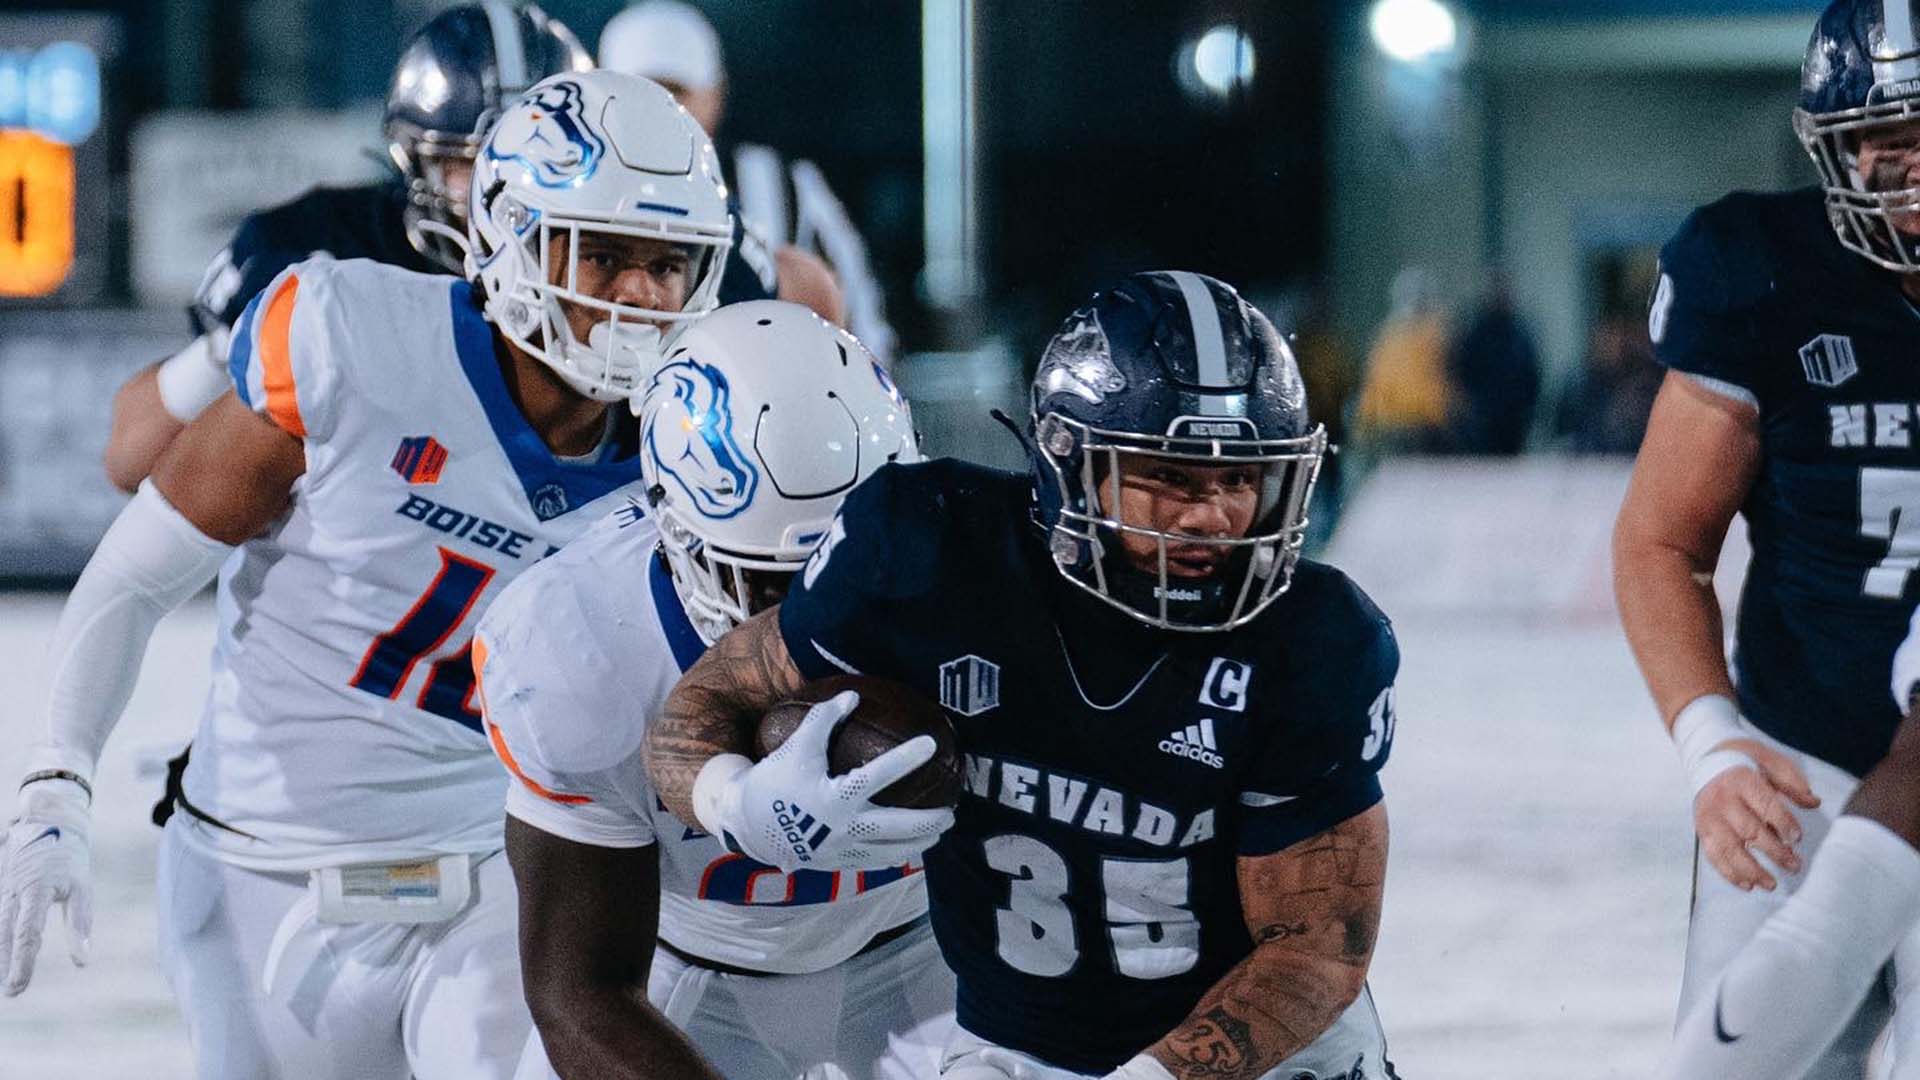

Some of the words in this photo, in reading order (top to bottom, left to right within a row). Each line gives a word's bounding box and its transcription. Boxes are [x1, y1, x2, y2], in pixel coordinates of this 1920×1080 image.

[1830, 404, 1920, 447] NE
[396, 493, 534, 559] BOISE
[1209, 659, 1244, 708] C
[1158, 740, 1224, 769] adidas
[772, 799, 812, 863] adidas
[962, 752, 1216, 848] NEVADA
[984, 833, 1201, 980] 35
